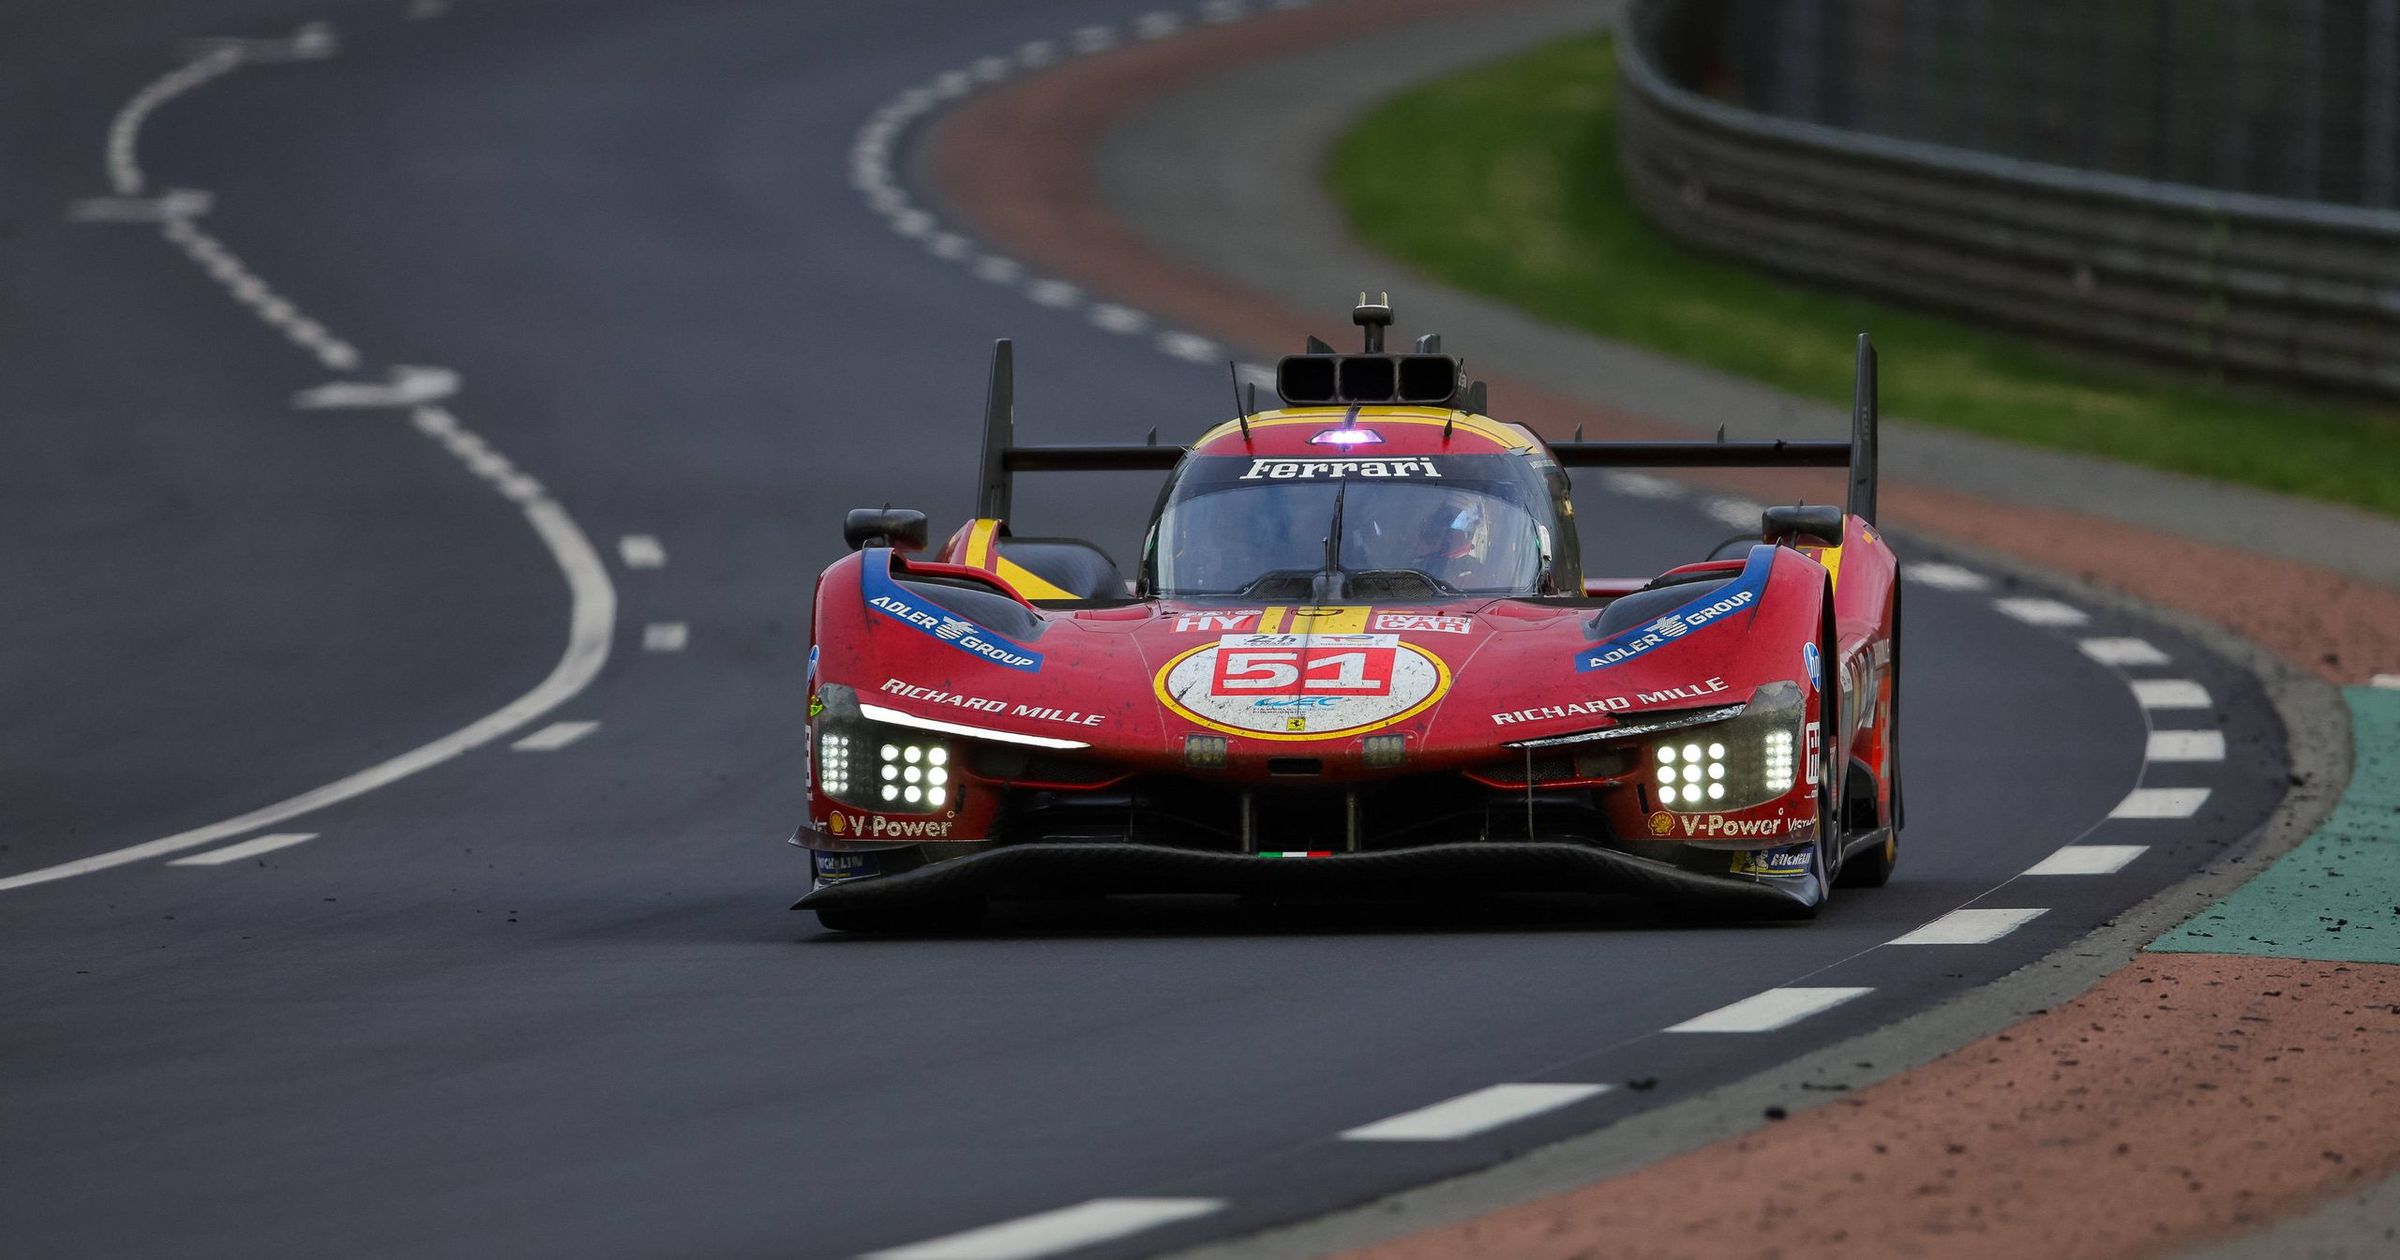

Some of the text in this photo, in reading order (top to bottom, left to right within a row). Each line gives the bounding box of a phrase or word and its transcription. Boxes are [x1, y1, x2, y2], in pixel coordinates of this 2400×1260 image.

[1239, 457, 1442, 480] Ferrari
[869, 596, 1035, 669] ADLER GROUP
[1381, 620, 1466, 632] CAR
[1588, 590, 1753, 668] ADLER GROUP
[1222, 652, 1382, 689] 51
[880, 678, 1106, 727] RICHARD MILLE
[1490, 676, 1730, 726] RICHARD MILLE
[849, 815, 953, 837] V-Power
[1680, 814, 1781, 837] V-Power
[1770, 853, 1812, 866] MICHELIN
